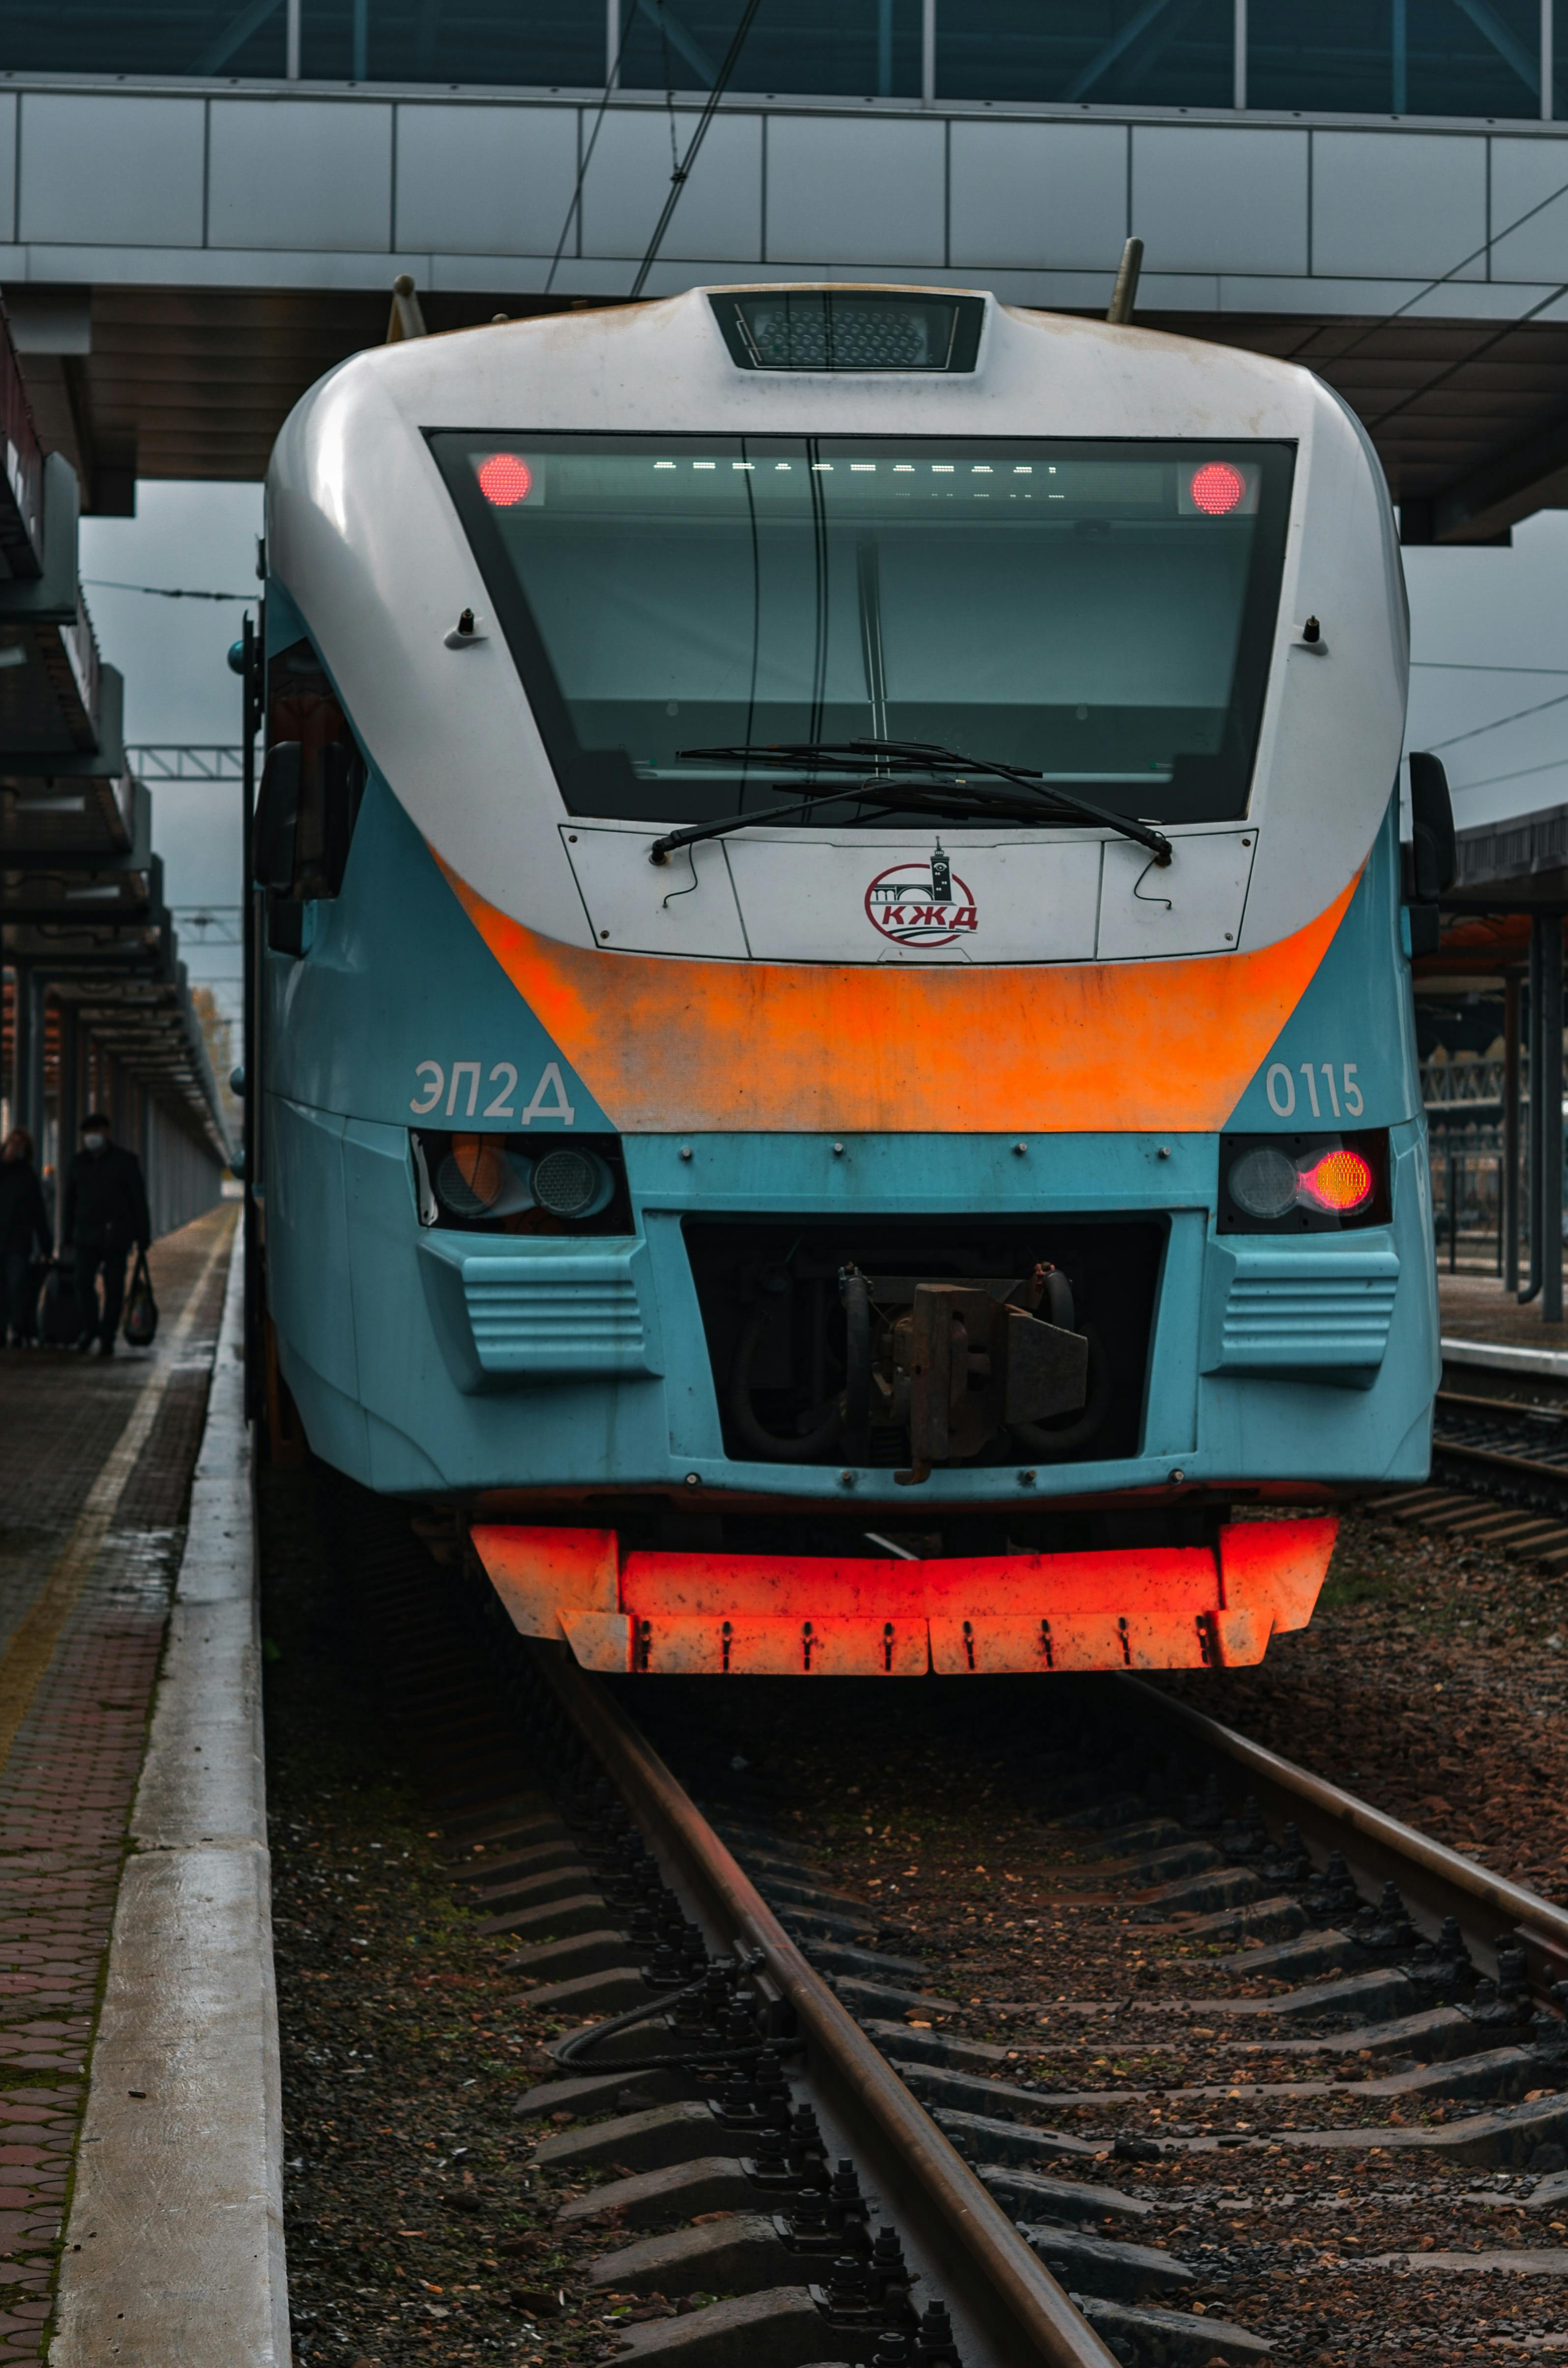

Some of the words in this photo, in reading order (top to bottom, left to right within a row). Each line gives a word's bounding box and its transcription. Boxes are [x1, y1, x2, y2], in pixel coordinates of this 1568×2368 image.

[882, 906, 978, 930] КЖД
[409, 1060, 575, 1125] ЭП2Д
[1266, 1062, 1365, 1117] 0115
